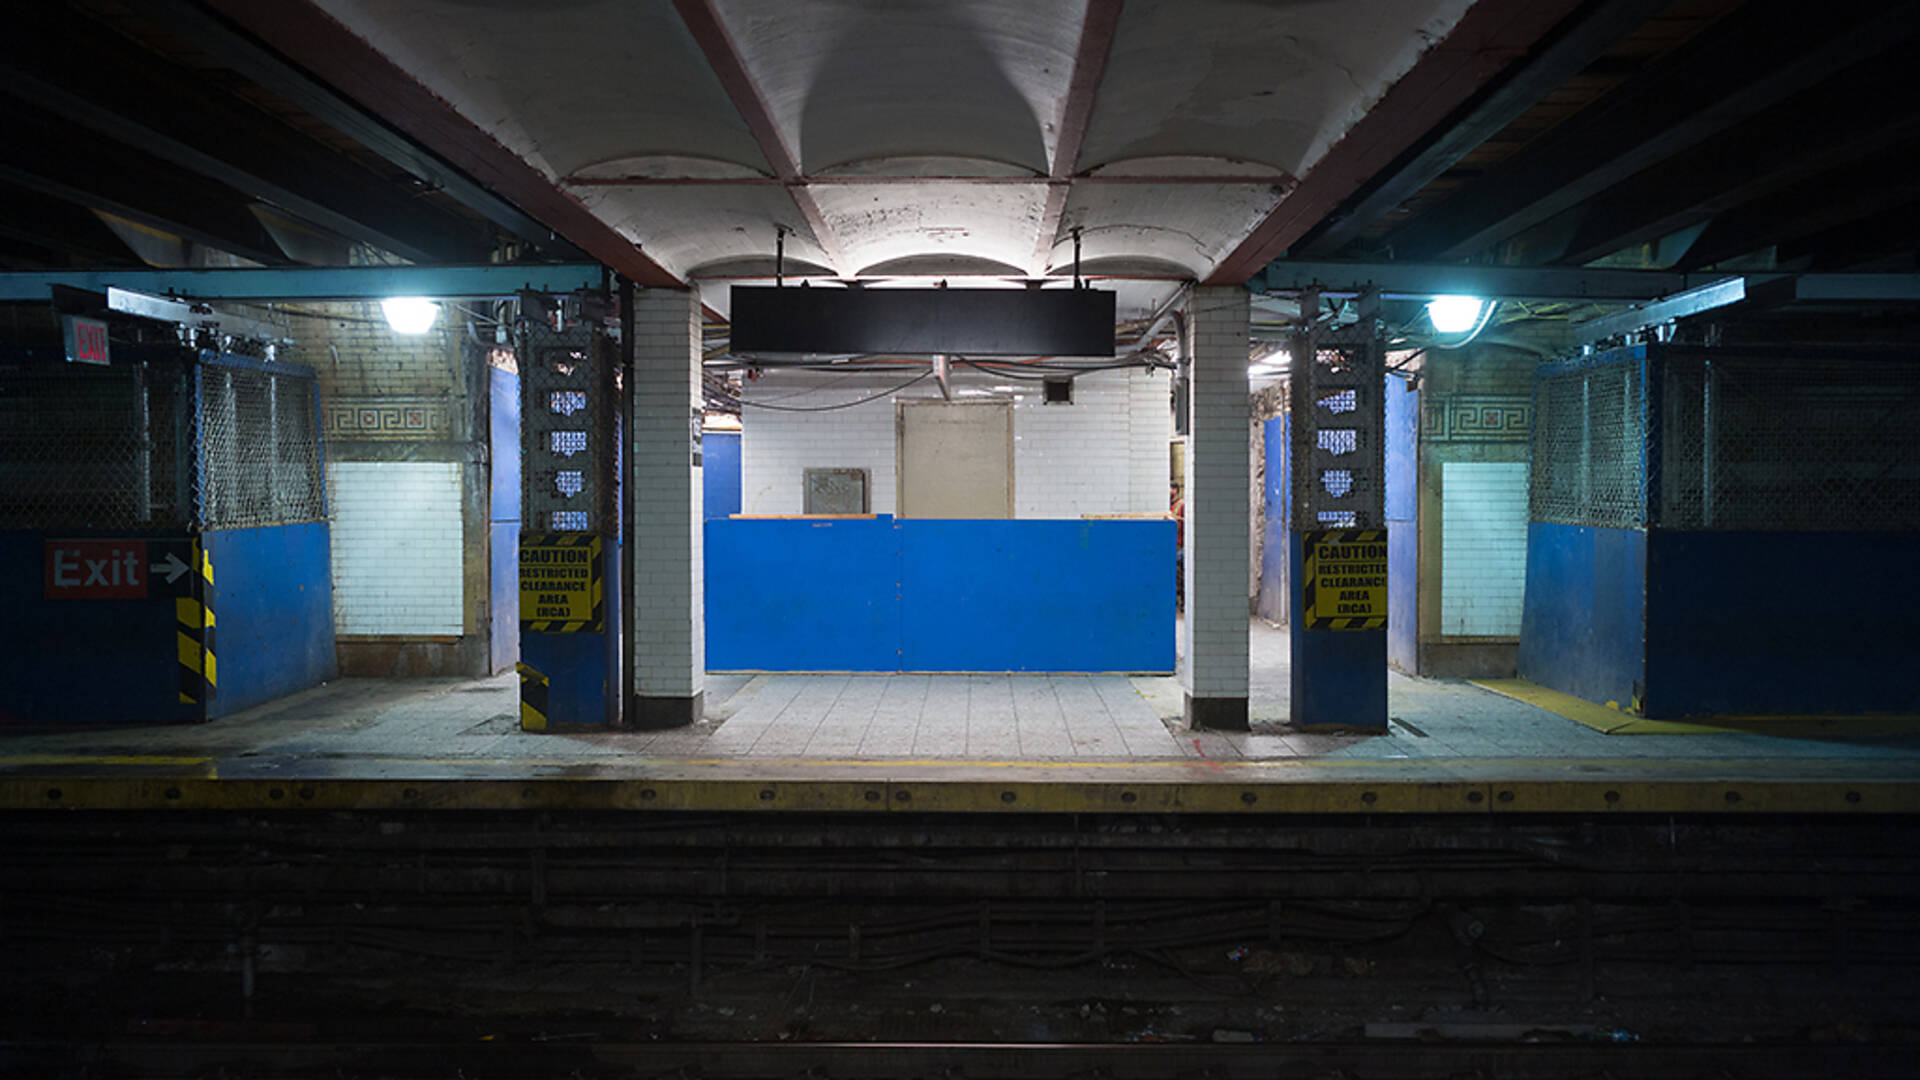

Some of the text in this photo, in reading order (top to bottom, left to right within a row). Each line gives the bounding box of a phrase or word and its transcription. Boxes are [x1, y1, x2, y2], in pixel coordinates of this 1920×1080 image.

[78, 323, 106, 361] EXIT
[520, 550, 587, 562] CAUTION
[1319, 545, 1387, 559] CAUTION
[54, 549, 139, 586] Exit
[520, 568, 588, 578] RESTRICTED
[521, 581, 586, 591] CLEARANCE
[538, 595, 568, 604] AREA
[1340, 590, 1369, 601] AREA
